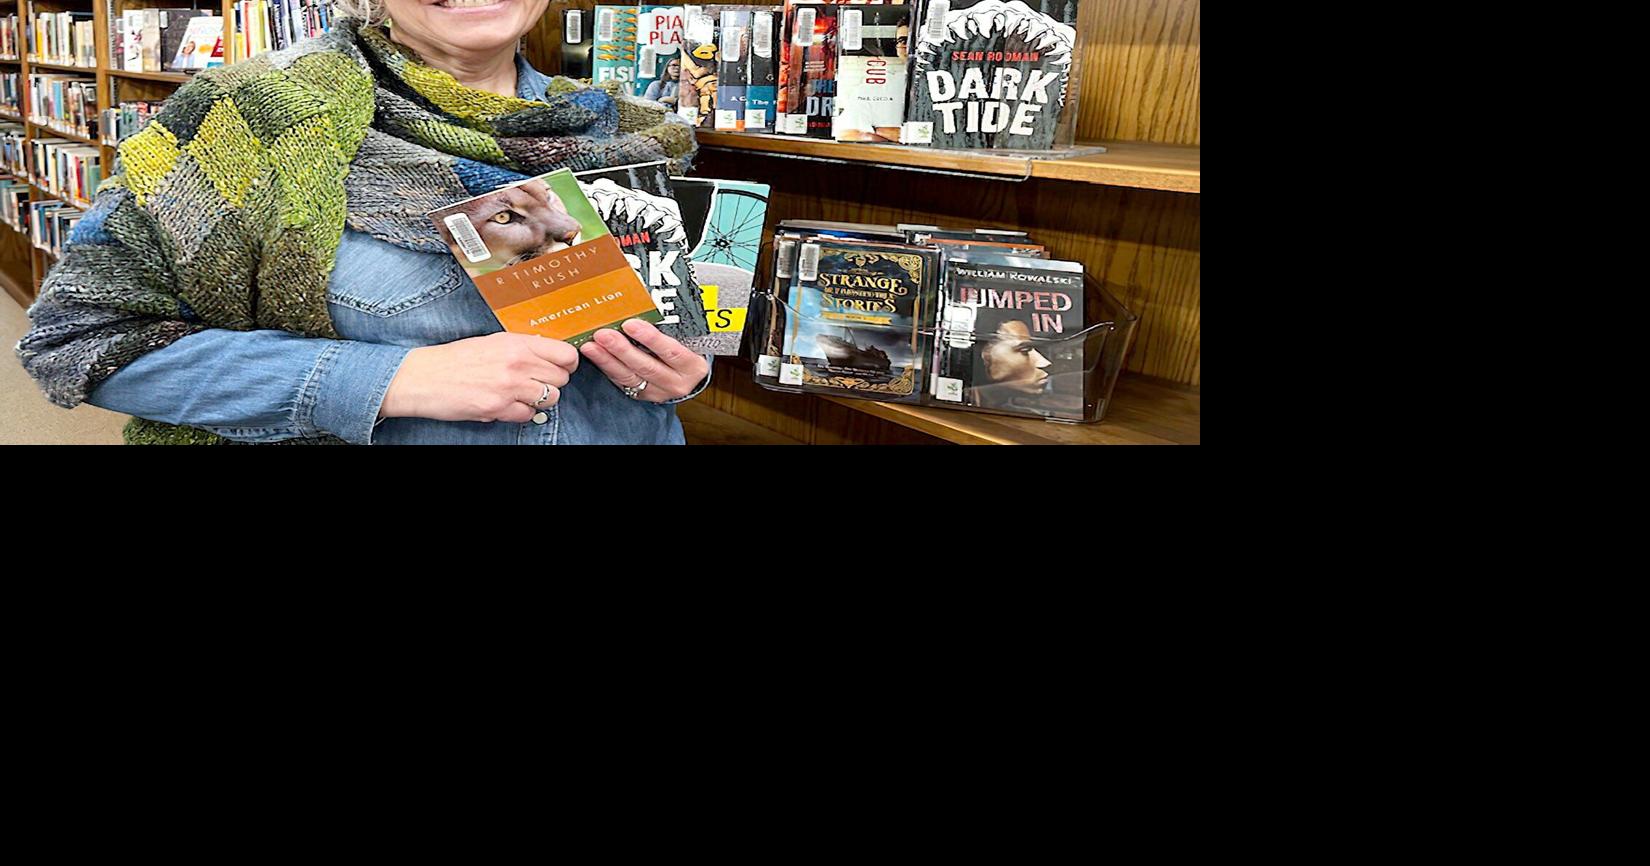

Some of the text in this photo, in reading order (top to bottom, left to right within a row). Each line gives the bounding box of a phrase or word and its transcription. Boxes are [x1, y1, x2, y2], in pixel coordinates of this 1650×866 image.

[951, 51, 1040, 62] SEAN RODMAN
[866, 60, 886, 85] CUB
[926, 67, 1060, 104] DARK
[933, 101, 1042, 136] TIDE
[496, 246, 598, 286] R TIMOTHY
[956, 266, 1072, 285] WILLIAM KOWALSKI
[532, 268, 580, 289] RUSH
[819, 272, 908, 296] STRANGE
[529, 290, 624, 327] American Lion
[822, 293, 897, 313] STORIES
[1031, 312, 1063, 334] IN
